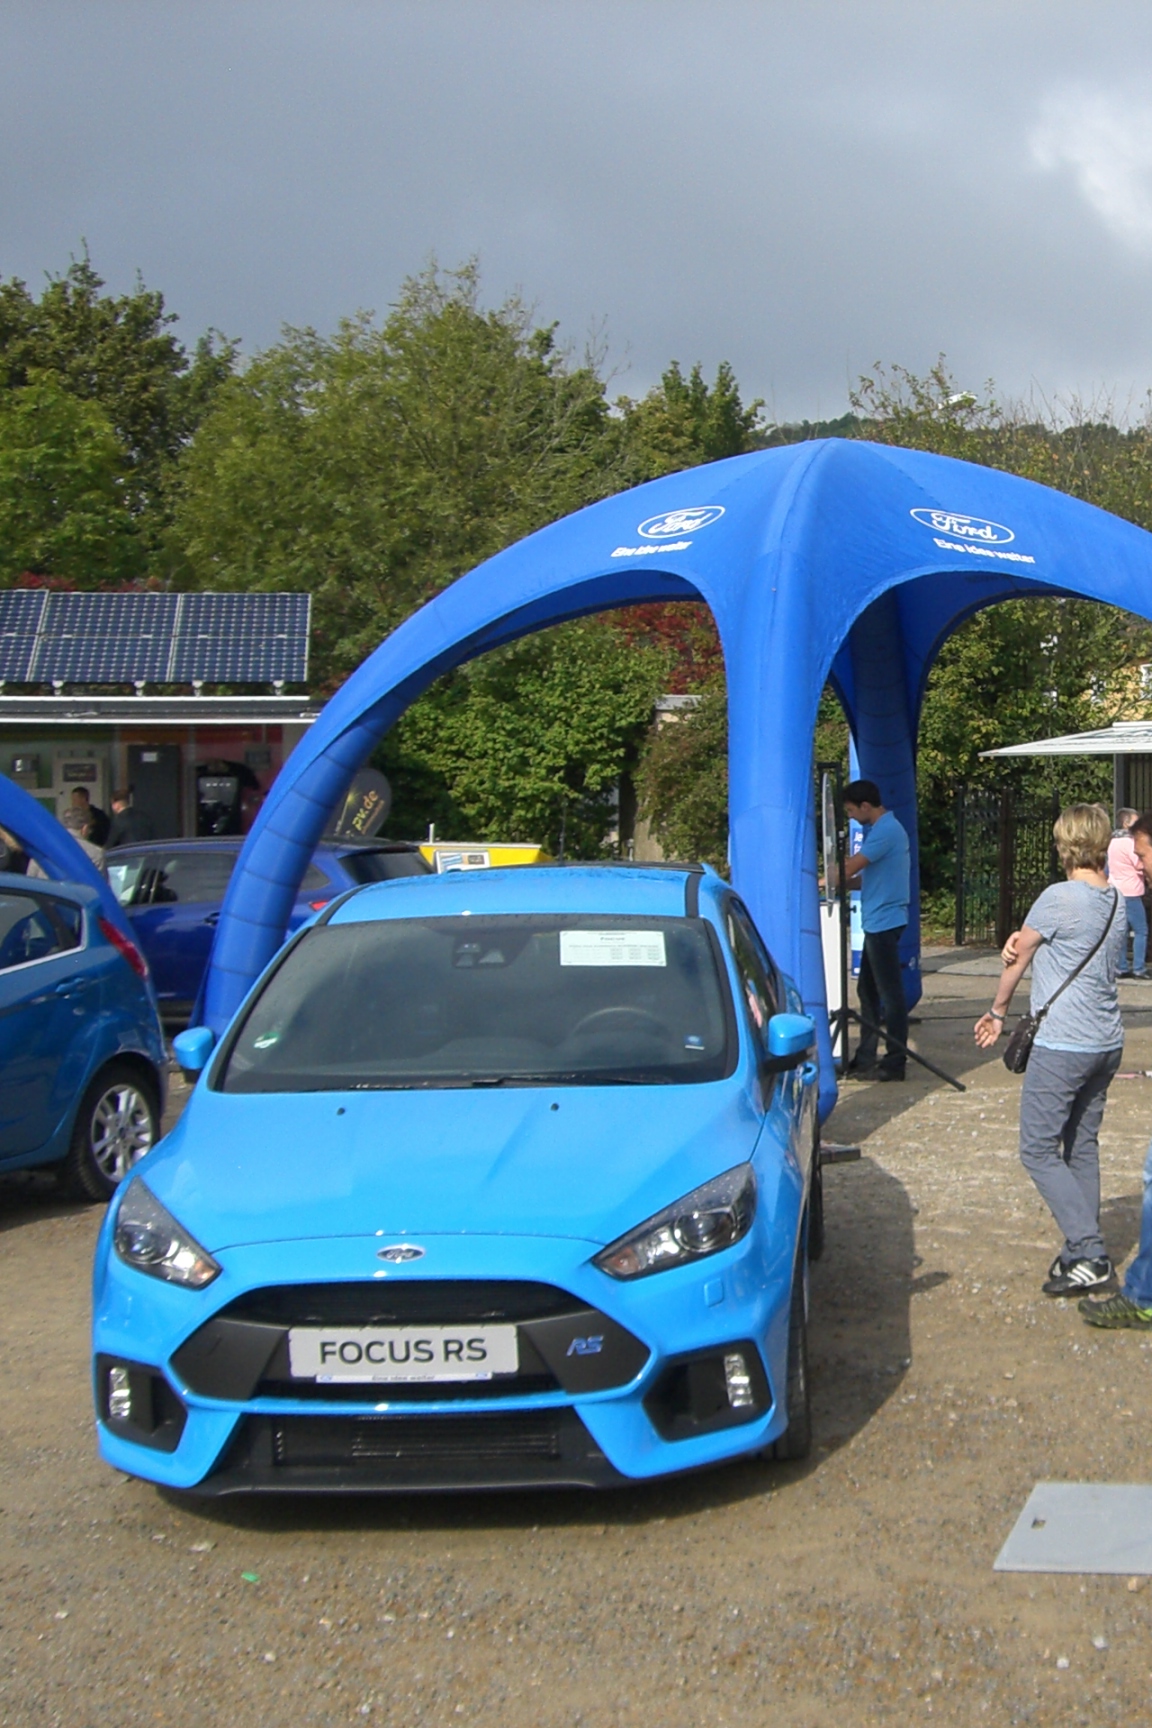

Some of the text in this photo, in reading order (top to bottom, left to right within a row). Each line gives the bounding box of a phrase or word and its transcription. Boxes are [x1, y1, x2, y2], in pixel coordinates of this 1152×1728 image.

[648, 510, 713, 534] Ford
[931, 512, 998, 540] Ford
[319, 1338, 488, 1365] FOCUS RS
